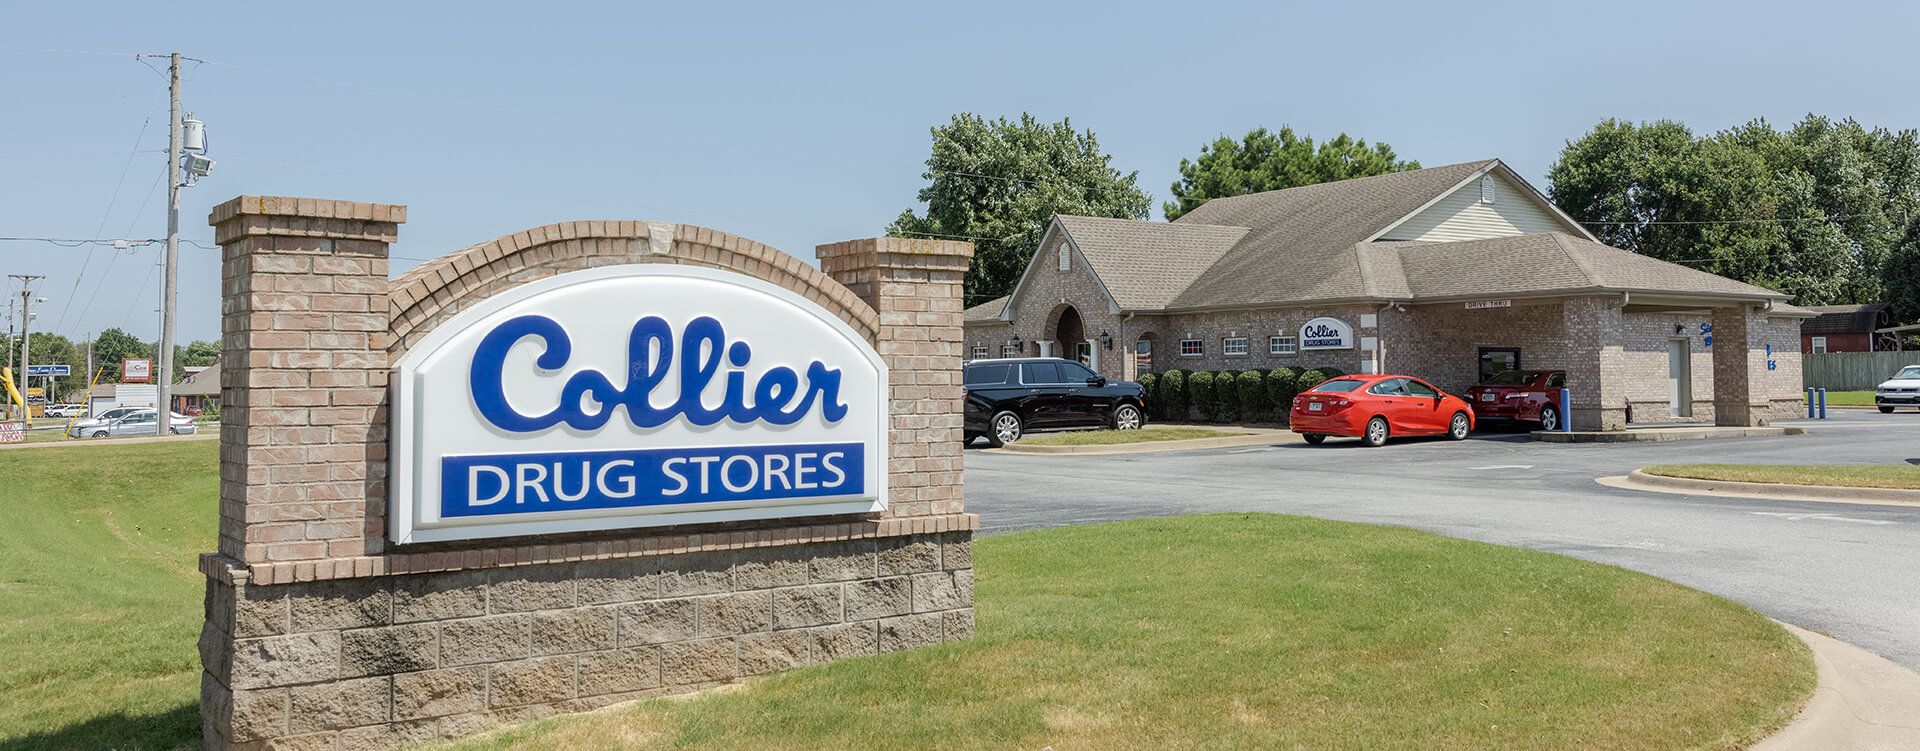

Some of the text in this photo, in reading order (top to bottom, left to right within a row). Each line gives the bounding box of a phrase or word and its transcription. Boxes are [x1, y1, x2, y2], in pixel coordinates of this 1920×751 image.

[1490, 299, 1507, 307] THRU
[1304, 325, 1339, 338] Collier
[470, 315, 848, 432] Collier
[468, 452, 846, 507] DRUG STORES
